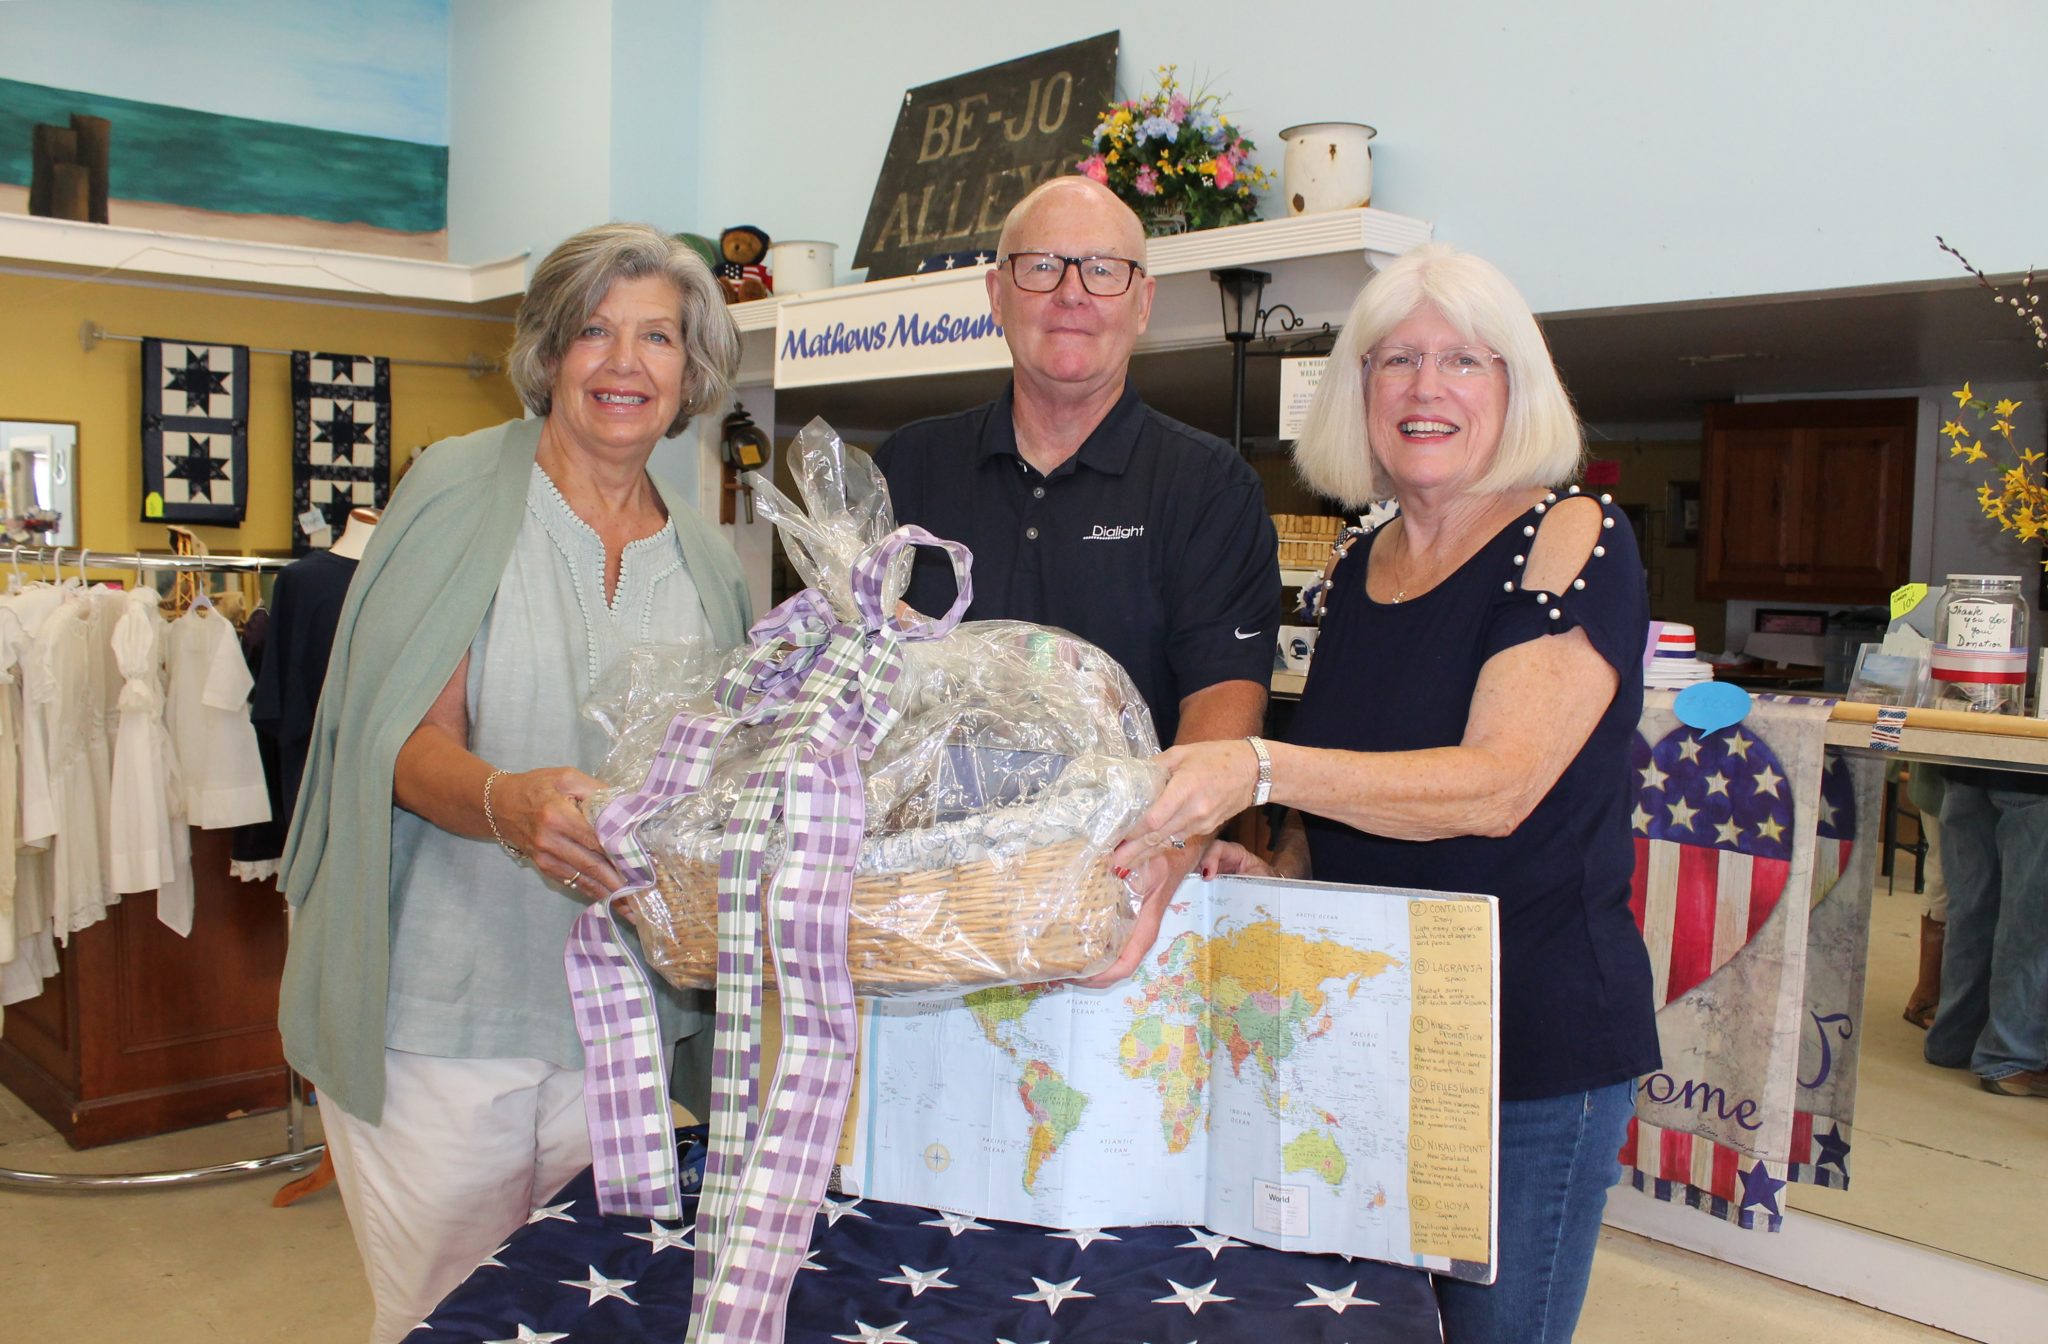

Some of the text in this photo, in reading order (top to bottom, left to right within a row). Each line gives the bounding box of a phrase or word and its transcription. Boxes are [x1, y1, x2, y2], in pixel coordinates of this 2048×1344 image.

[916, 70, 1073, 165] BE-JO
[871, 154, 1082, 253] ALLEY
[781, 312, 1004, 361] Mathews Museum
[1092, 524, 1145, 540] Dialight
[1946, 605, 1984, 617] Thank
[1963, 612, 2008, 630] you for
[1970, 625, 1993, 638] your
[1957, 634, 2003, 648] Donation
[1430, 903, 1482, 913] CONTADINO
[1071, 1008, 1095, 1016] OCEAN
[1350, 1031, 1379, 1040] PACIFIC
[1352, 1040, 1377, 1048] OCEAN
[1637, 1073, 1764, 1131] ome
[1098, 1138, 1135, 1146] ATLANTIC
[1103, 1147, 1128, 1155] OCEAN
[1269, 1193, 1290, 1204] World
[1435, 1199, 1471, 1211] CHOYA
